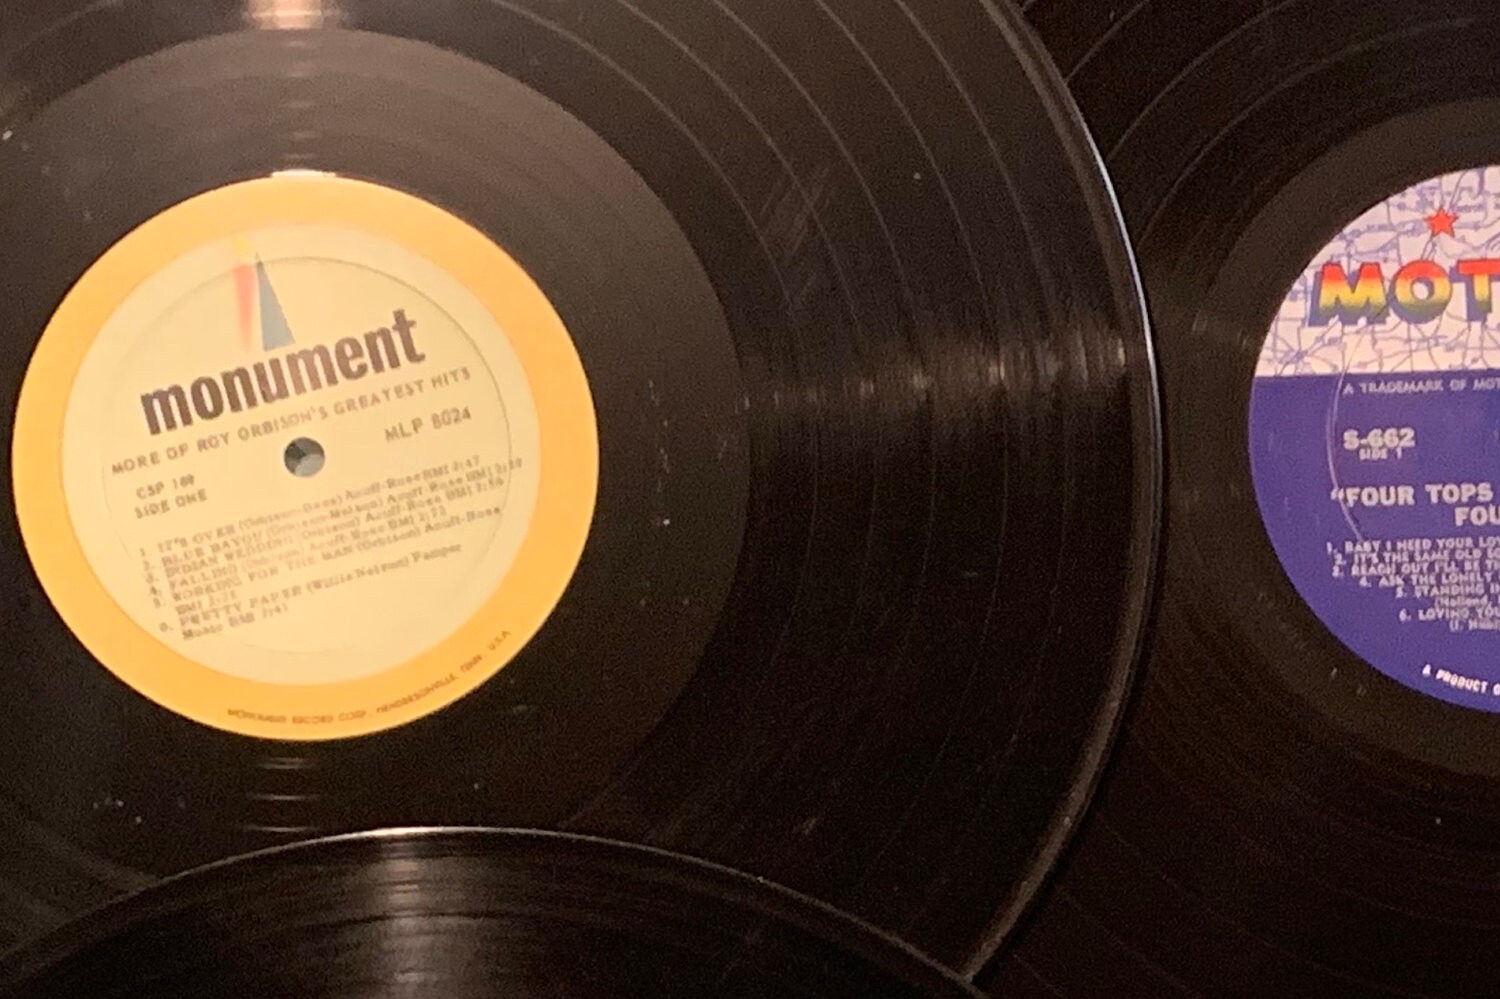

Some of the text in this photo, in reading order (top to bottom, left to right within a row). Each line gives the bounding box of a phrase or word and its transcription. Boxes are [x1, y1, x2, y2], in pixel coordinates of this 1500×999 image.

[140, 309, 426, 436] monument
[1343, 381, 1355, 395] A
[1360, 377, 1444, 395] TRADEMARK
[1450, 379, 1468, 392] OF
[111, 366, 472, 475] MORE OF ROY ORBISON'S GREATEST HITS
[384, 405, 473, 443] MLP 8024
[1342, 427, 1416, 450] S-662
[1424, 483, 1494, 504] TOPS
[134, 499, 171, 519] SIDE
[1344, 540, 1381, 553] BABY
[1396, 538, 1432, 551] NEED
[1435, 536, 1474, 550] YOUR
[1454, 548, 1483, 560] OLD
[1400, 561, 1429, 575] OUT
[1422, 663, 1432, 677] A
[1435, 668, 1488, 694] PRODUCT
